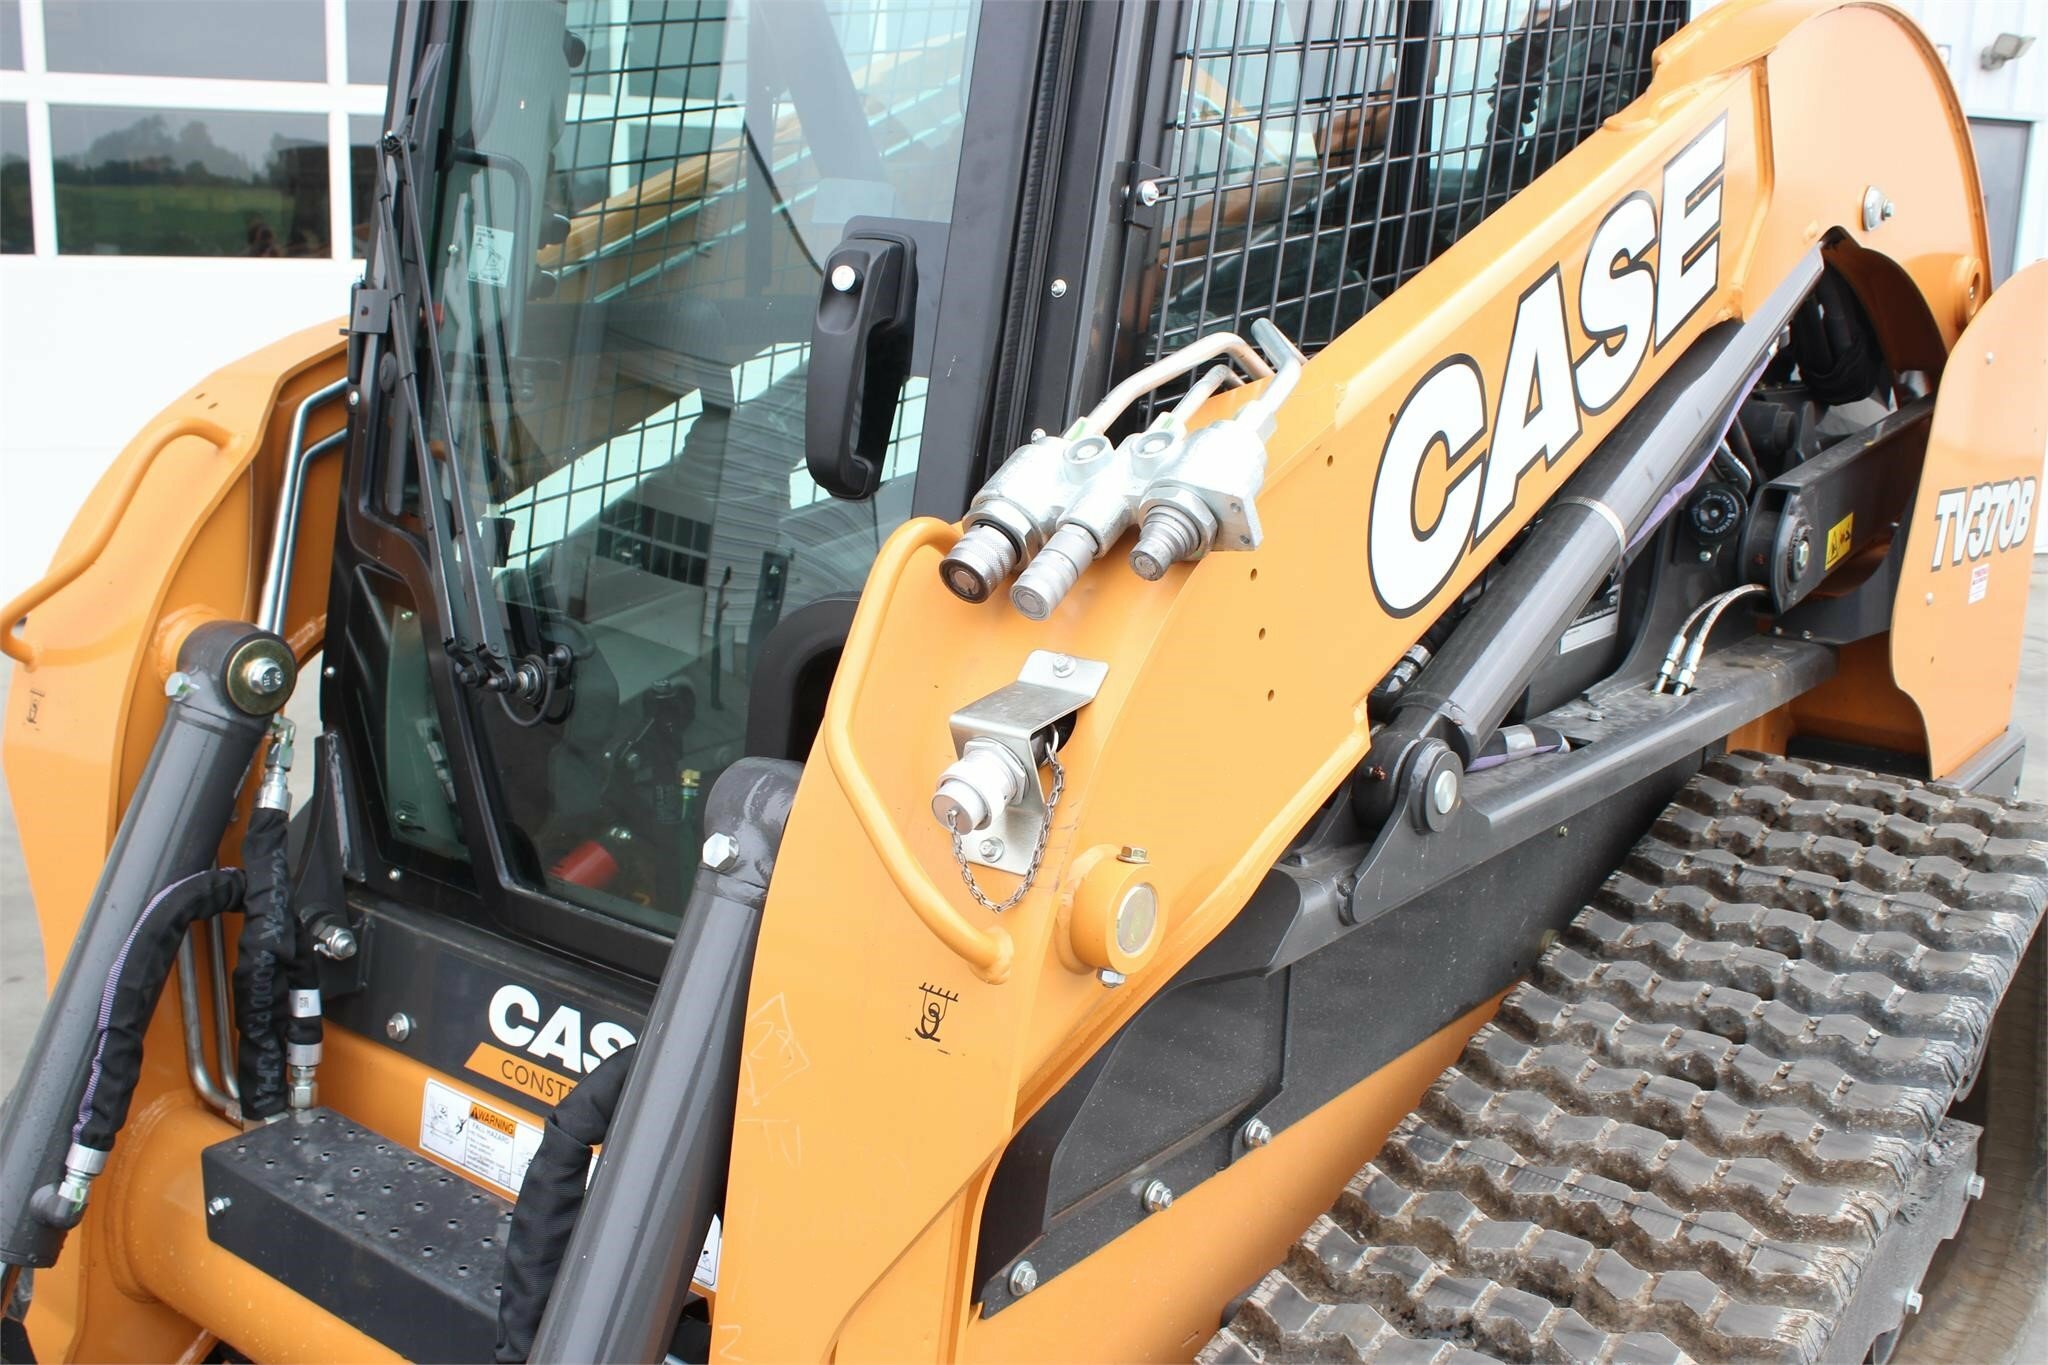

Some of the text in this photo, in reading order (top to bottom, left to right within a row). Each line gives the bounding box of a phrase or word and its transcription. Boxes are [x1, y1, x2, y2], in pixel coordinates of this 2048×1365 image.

[1367, 111, 1728, 618] CASE
[1932, 477, 2036, 572] TV370B
[477, 1111, 514, 1136] WARNING
